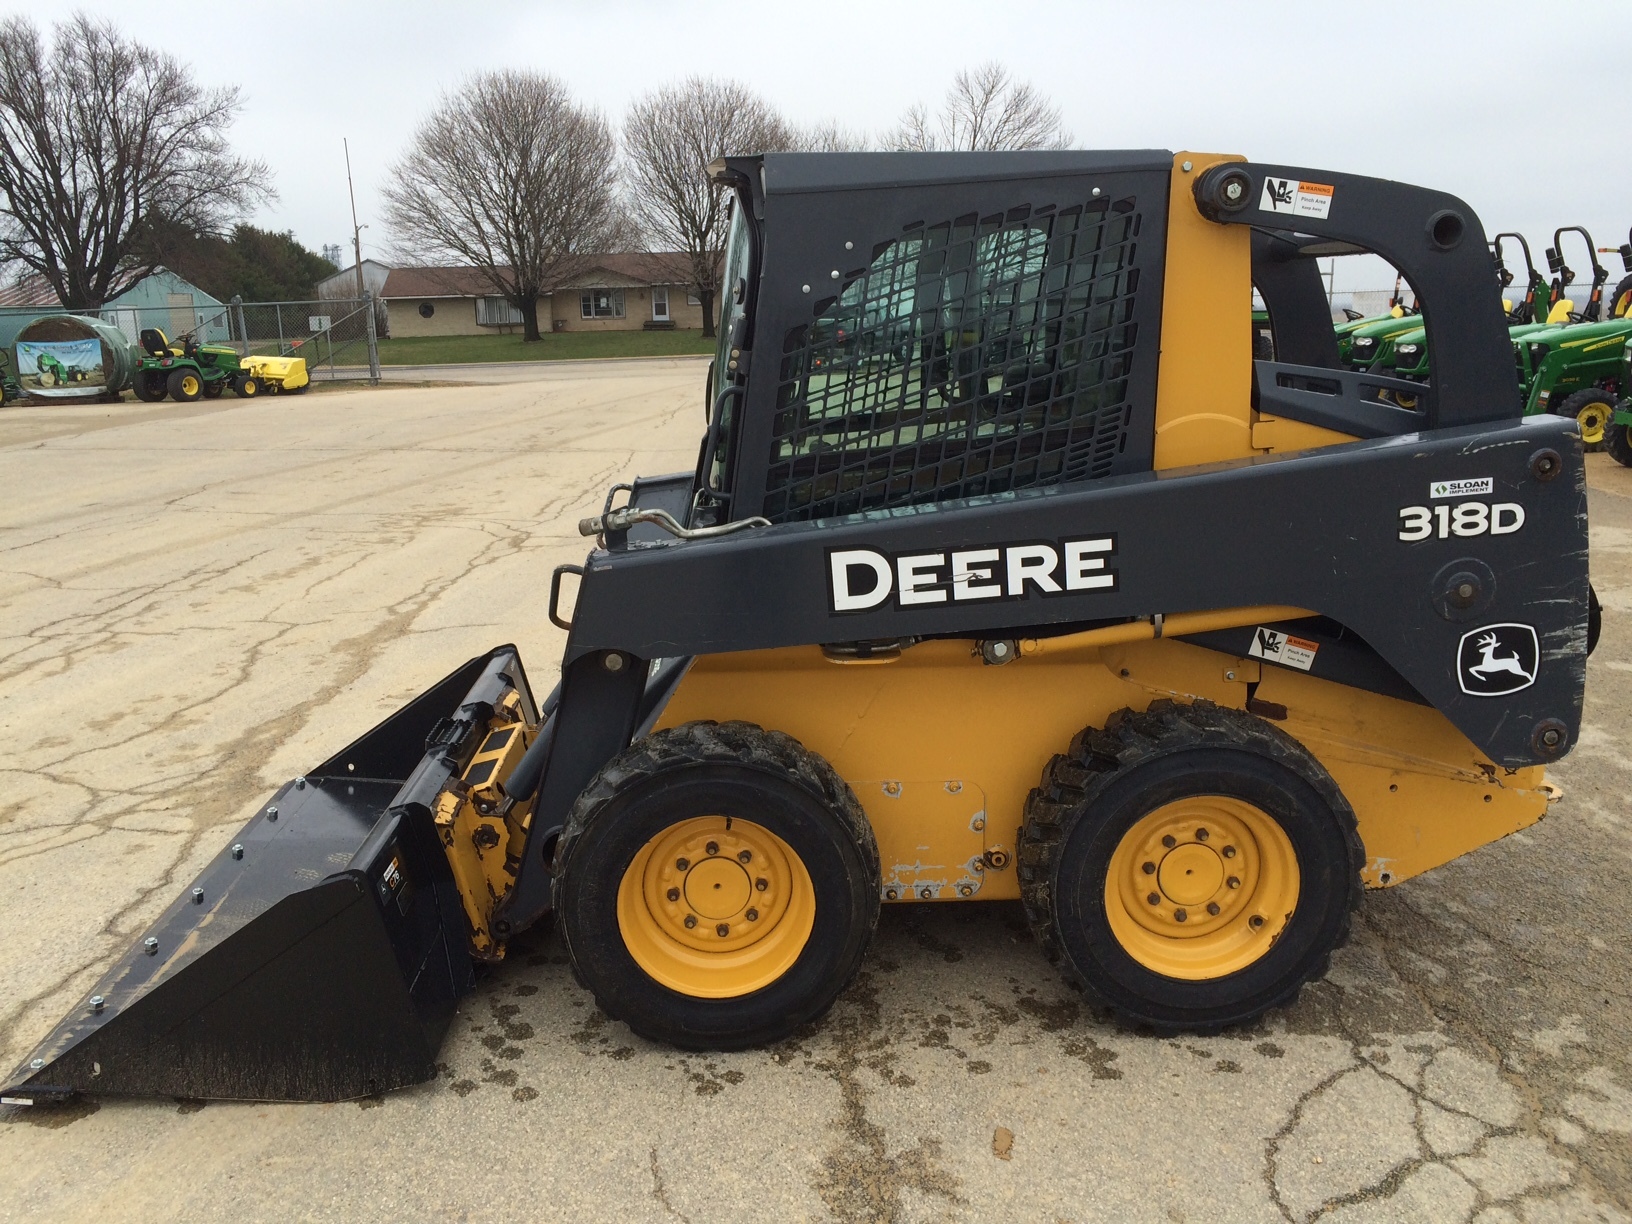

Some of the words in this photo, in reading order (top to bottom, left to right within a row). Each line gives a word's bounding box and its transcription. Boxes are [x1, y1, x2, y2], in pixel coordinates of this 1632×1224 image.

[1450, 480, 1489, 490] SLOAN
[1399, 501, 1525, 541] 318D
[830, 538, 1114, 611] DEERE
[1294, 640, 1315, 649] WARNING
